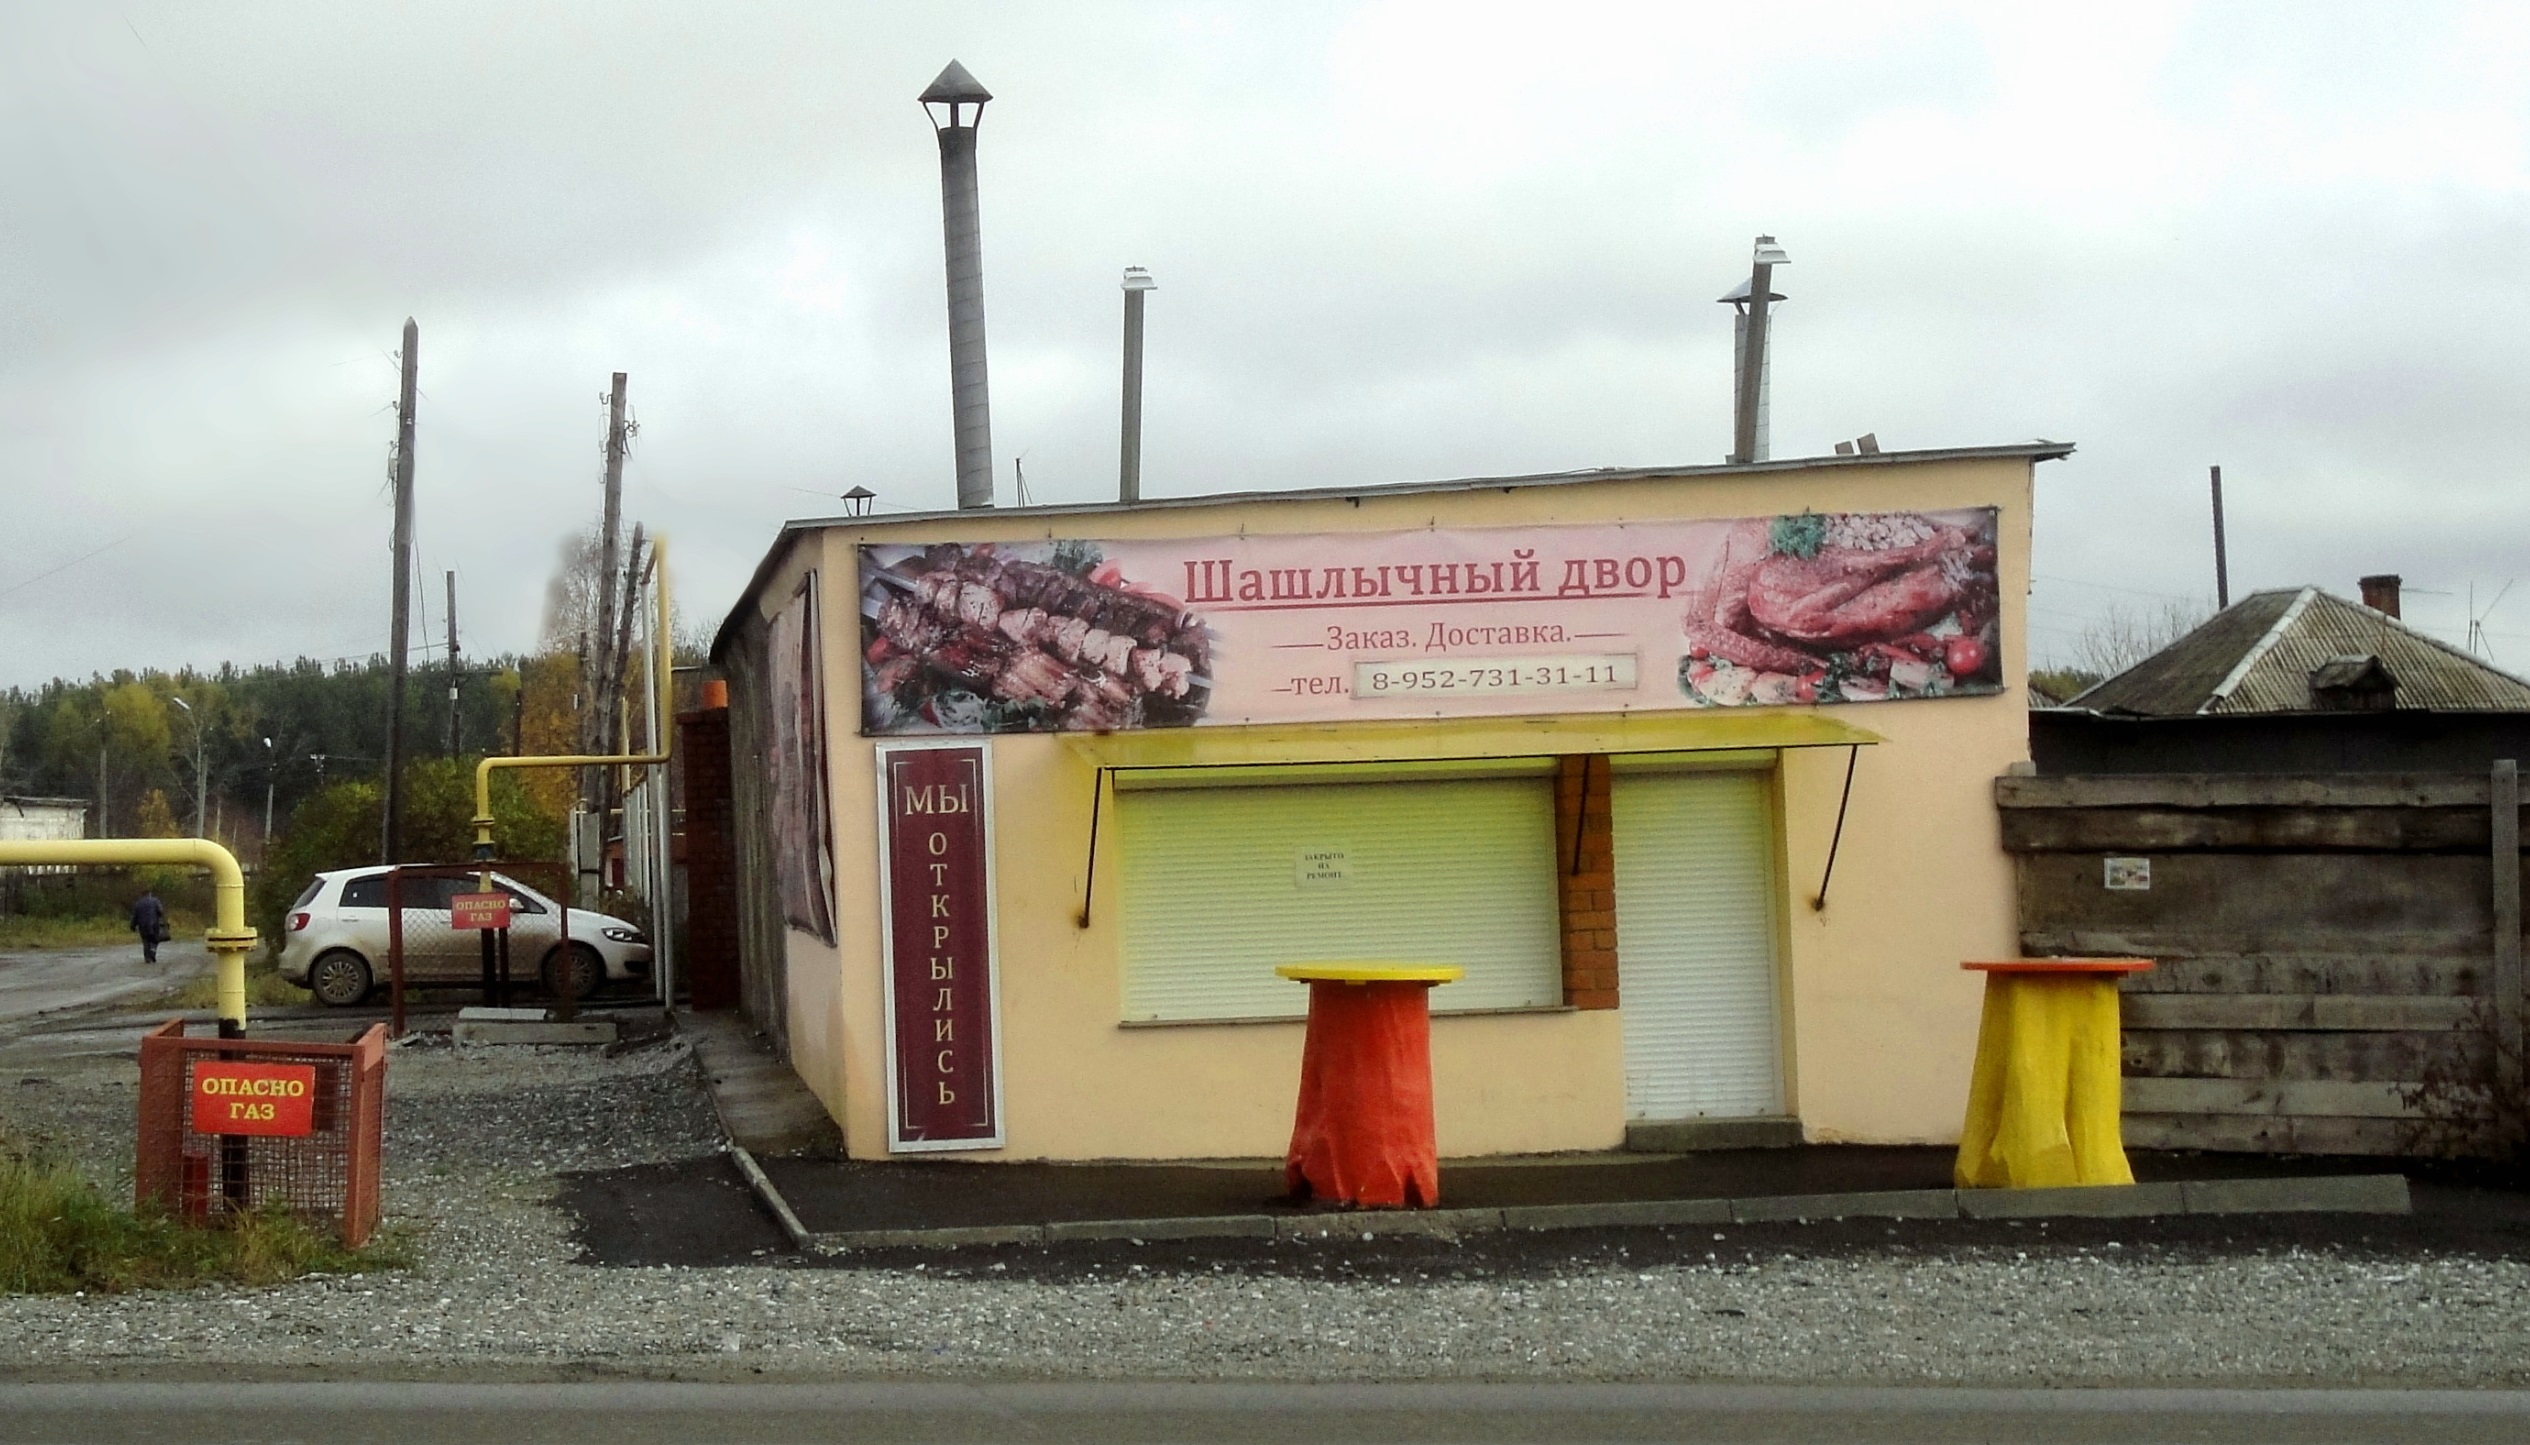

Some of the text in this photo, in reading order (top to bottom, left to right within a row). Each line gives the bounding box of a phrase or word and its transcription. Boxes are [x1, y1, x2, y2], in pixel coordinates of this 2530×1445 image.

[1183, 549, 1687, 602] Шашлычный двор
[1326, 621, 1572, 651] Заказ. Доставка.
[1291, 664, 1618, 696] тел. 8-952-731-31-11
[905, 784, 968, 815] МЫ
[456, 900, 505, 910] ОПАСНО
[470, 912, 492, 921] ГАЗ
[928, 832, 956, 1105] ОТКРЫЛИСЬ
[202, 1078, 304, 1096] ОПАСНО
[230, 1102, 275, 1119] ГАЗ
